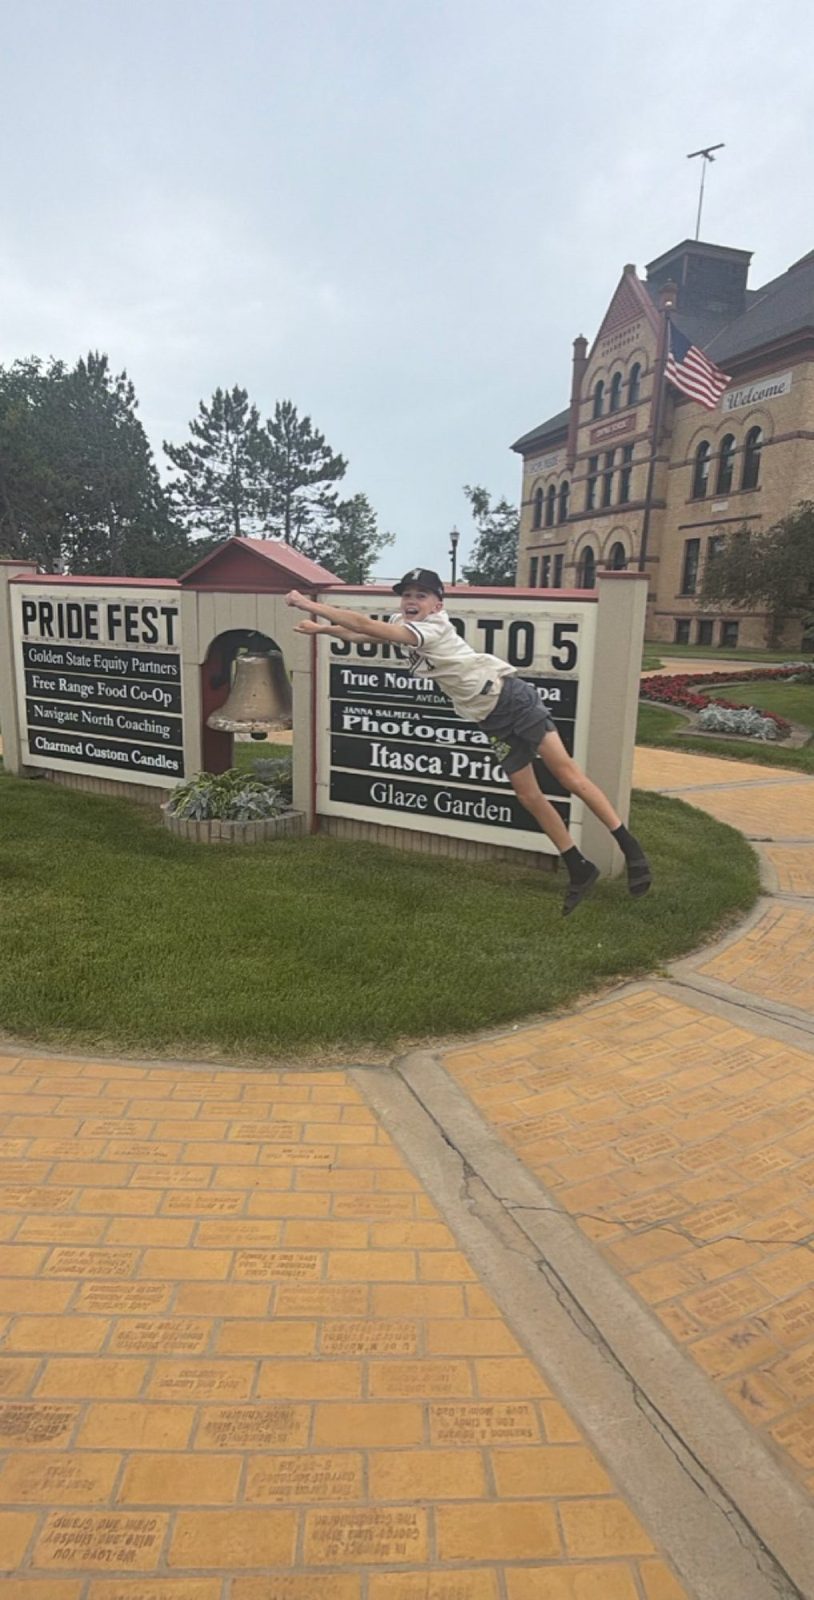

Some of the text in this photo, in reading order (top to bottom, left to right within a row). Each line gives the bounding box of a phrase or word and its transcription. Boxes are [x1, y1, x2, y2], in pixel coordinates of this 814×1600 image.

[727, 382, 786, 409] Welcome
[22, 601, 178, 646] PRIDE FEST
[477, 619, 534, 668] TO
[551, 622, 579, 671] 5
[28, 648, 178, 676] Golden State Equity Partners
[32, 675, 173, 708] Free Range Food Co-Op
[340, 669, 561, 702] True North pa
[416, 694, 447, 705] AVEDA
[34, 705, 171, 739] Navigate North Coaching
[343, 706, 420, 721] JANNA SALMELA
[35, 736, 179, 771] Charmed Custom Candles
[369, 742, 442, 775] Itasca
[370, 781, 512, 823] Glaze Garden
